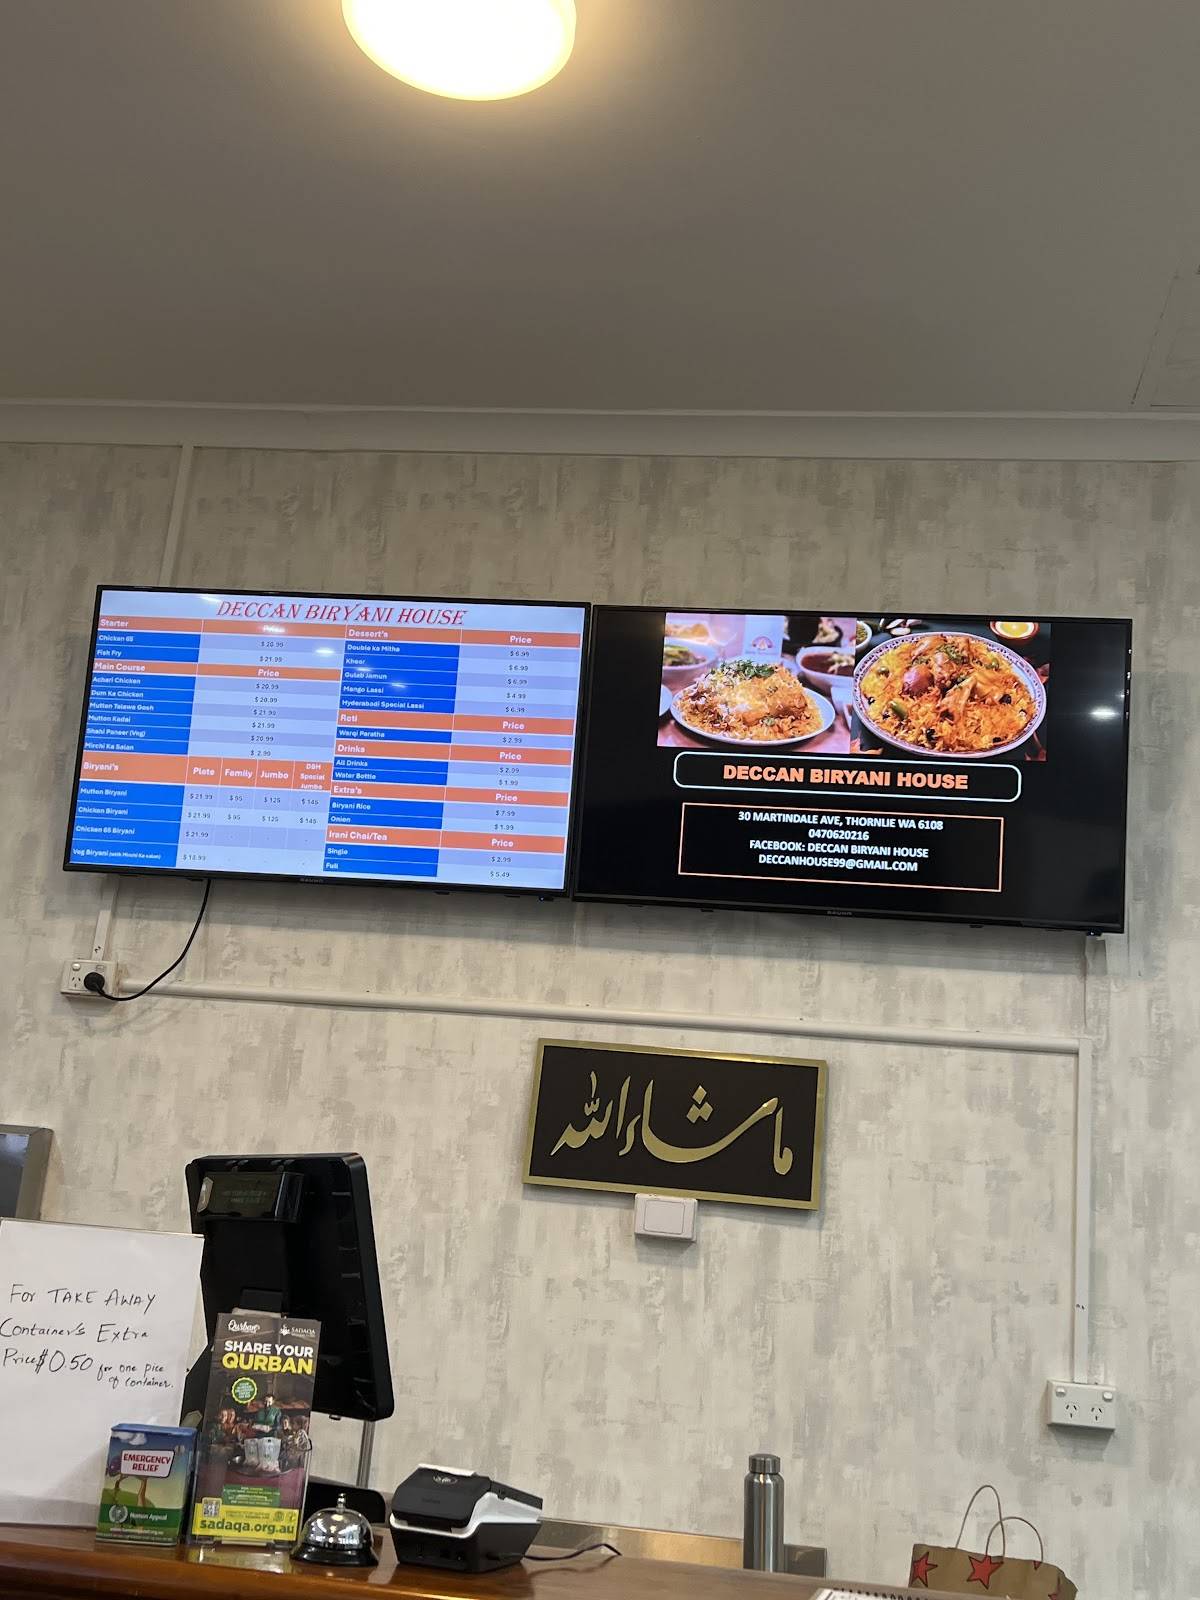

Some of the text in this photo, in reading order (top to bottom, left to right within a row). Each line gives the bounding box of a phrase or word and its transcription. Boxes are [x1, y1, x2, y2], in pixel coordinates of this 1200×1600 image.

[216, 601, 468, 625] DECCAN BIRYANI HOUSE
[100, 619, 128, 627] Starter
[348, 630, 388, 638] Dessert's
[510, 635, 532, 643] Price
[94, 662, 145, 672] Main Course
[258, 669, 280, 677] Price
[342, 700, 380, 708] Hyderabadi
[340, 714, 358, 723] Roti
[502, 721, 525, 730] Price
[337, 744, 366, 753] Drinks
[499, 751, 522, 761] Price
[83, 761, 119, 772] Biryani's
[193, 767, 215, 776] Plate
[225, 769, 253, 779] Family
[260, 771, 289, 780] Jumbo
[300, 773, 325, 781] Special
[723, 764, 969, 790] DECCAN BIRYANI HOUSE
[301, 783, 323, 791] Jumbo
[333, 785, 362, 795] Extra's
[104, 789, 128, 797] Biryani
[495, 793, 518, 802] Price
[78, 806, 129, 816] Chicken Biryani
[332, 802, 355, 810] Biryani
[738, 811, 944, 831] 30 MARTINDALE AVE, THORNLIE WA 6108
[75, 825, 102, 833] Chicken
[112, 827, 135, 836] Biryani
[808, 828, 870, 841] 0470620216
[328, 831, 388, 841] Irani Chai/Tea
[491, 838, 514, 847] Price
[72, 848, 85, 856] Veg
[85, 849, 109, 858] Biryani
[327, 848, 348, 856] Single
[749, 840, 929, 858] FACEBOOK: DECCAN BIRYANI HOUSE
[326, 862, 339, 870] Full
[758, 854, 918, 872] DECCANHOUSE99@GMAIL.COM
[10, 1284, 156, 1315] For TAKE AWAY
[96, 1323, 149, 1343] Extra
[224, 1340, 314, 1358] SHARE YOUR
[222, 1352, 313, 1375] QURBAN
[97, 1364, 113, 1382] for
[119, 1364, 137, 1373] one
[123, 1453, 171, 1465] EMERGENCY
[132, 1463, 159, 1472] RELIEF
[199, 1518, 294, 1535] sadaqa.org.au
